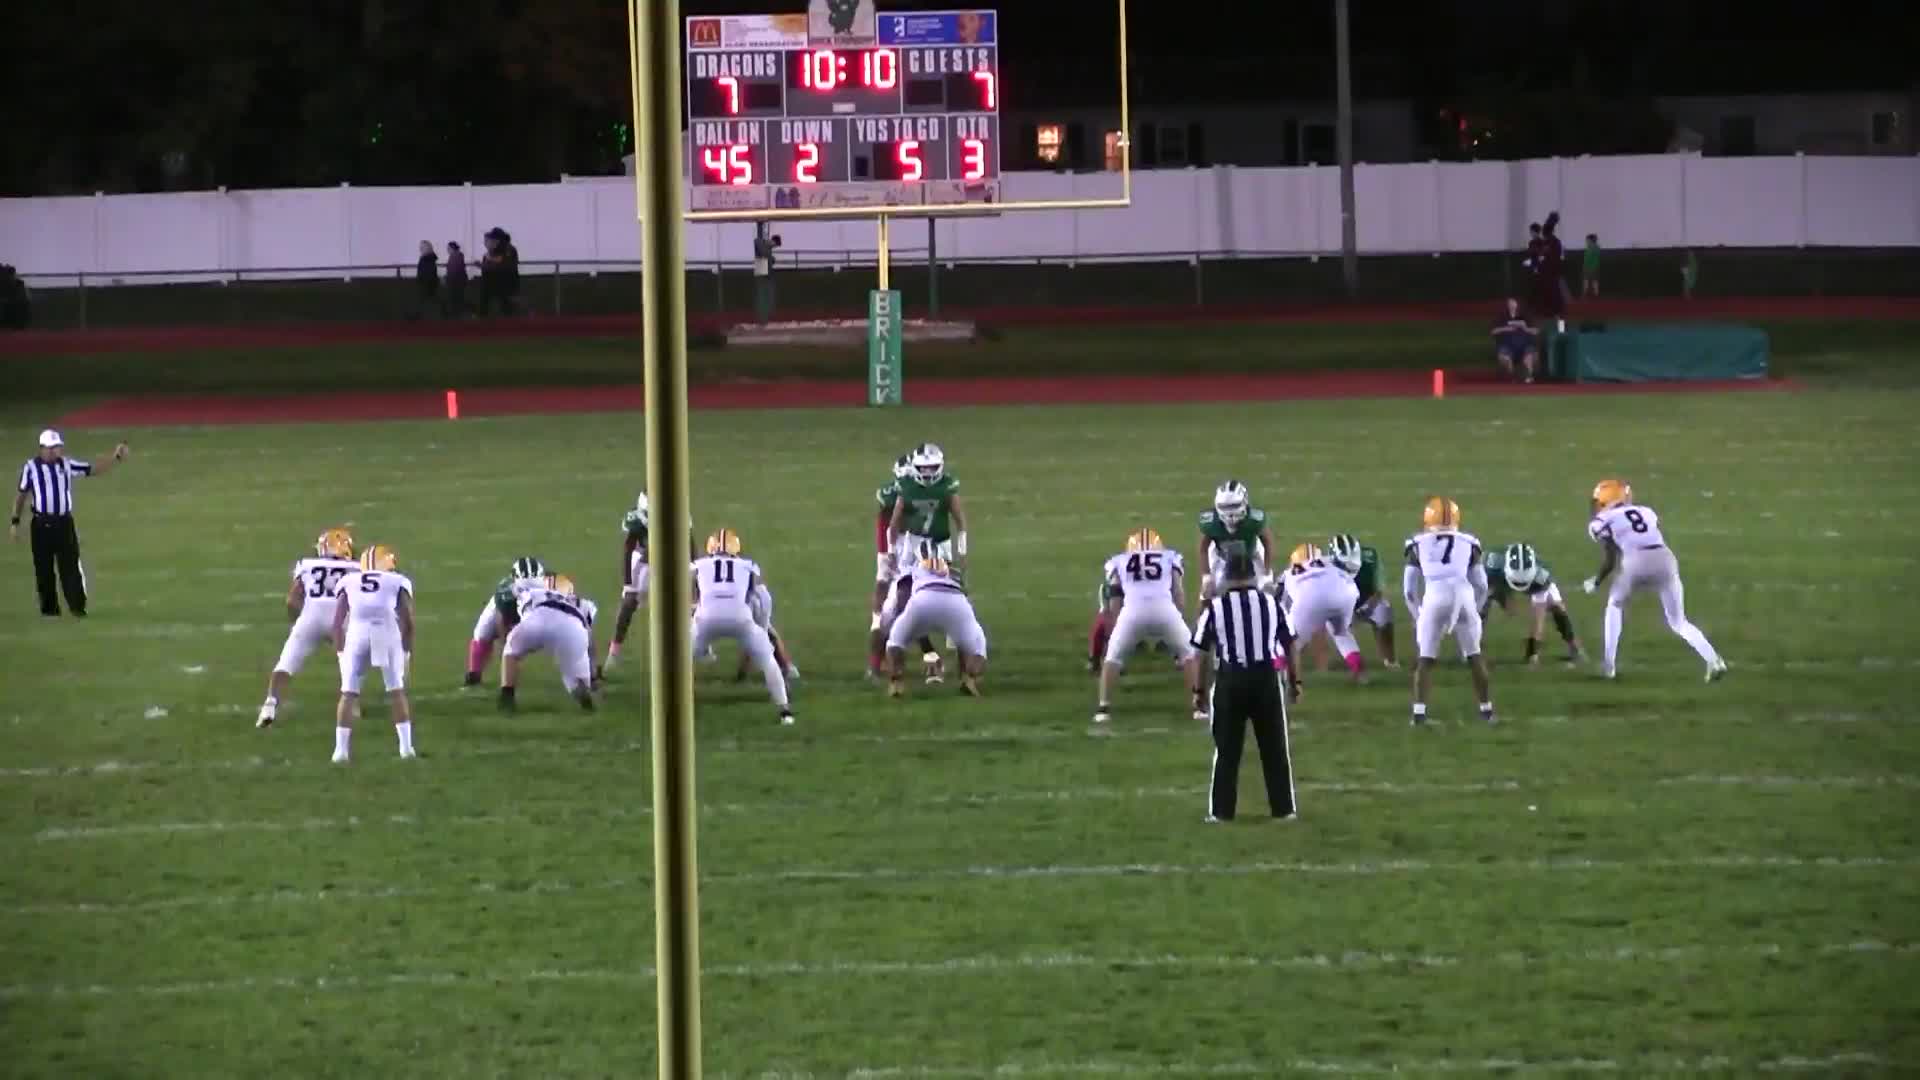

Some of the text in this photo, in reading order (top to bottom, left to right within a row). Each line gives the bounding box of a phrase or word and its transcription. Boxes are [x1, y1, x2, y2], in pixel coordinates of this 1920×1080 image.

[696, 53, 776, 77] DRAGONS
[804, 49, 896, 89] 10:10
[909, 48, 988, 72] GUESTS
[719, 77, 738, 113] 7
[974, 72, 994, 108] 7
[696, 122, 760, 145] BALL ON
[781, 120, 832, 144] DOWN
[893, 119, 912, 141] TO
[917, 118, 939, 140] GO
[705, 145, 751, 185] 45
[797, 144, 818, 183] 2
[900, 141, 922, 180] 5
[964, 140, 984, 180] 3
[875, 292, 891, 404] BRICK
[911, 499, 940, 533] 7
[1623, 509, 1648, 534] 8
[1436, 534, 1455, 565] 7
[713, 559, 735, 583] 11
[1125, 553, 1162, 581] 45
[360, 573, 382, 593] 5
